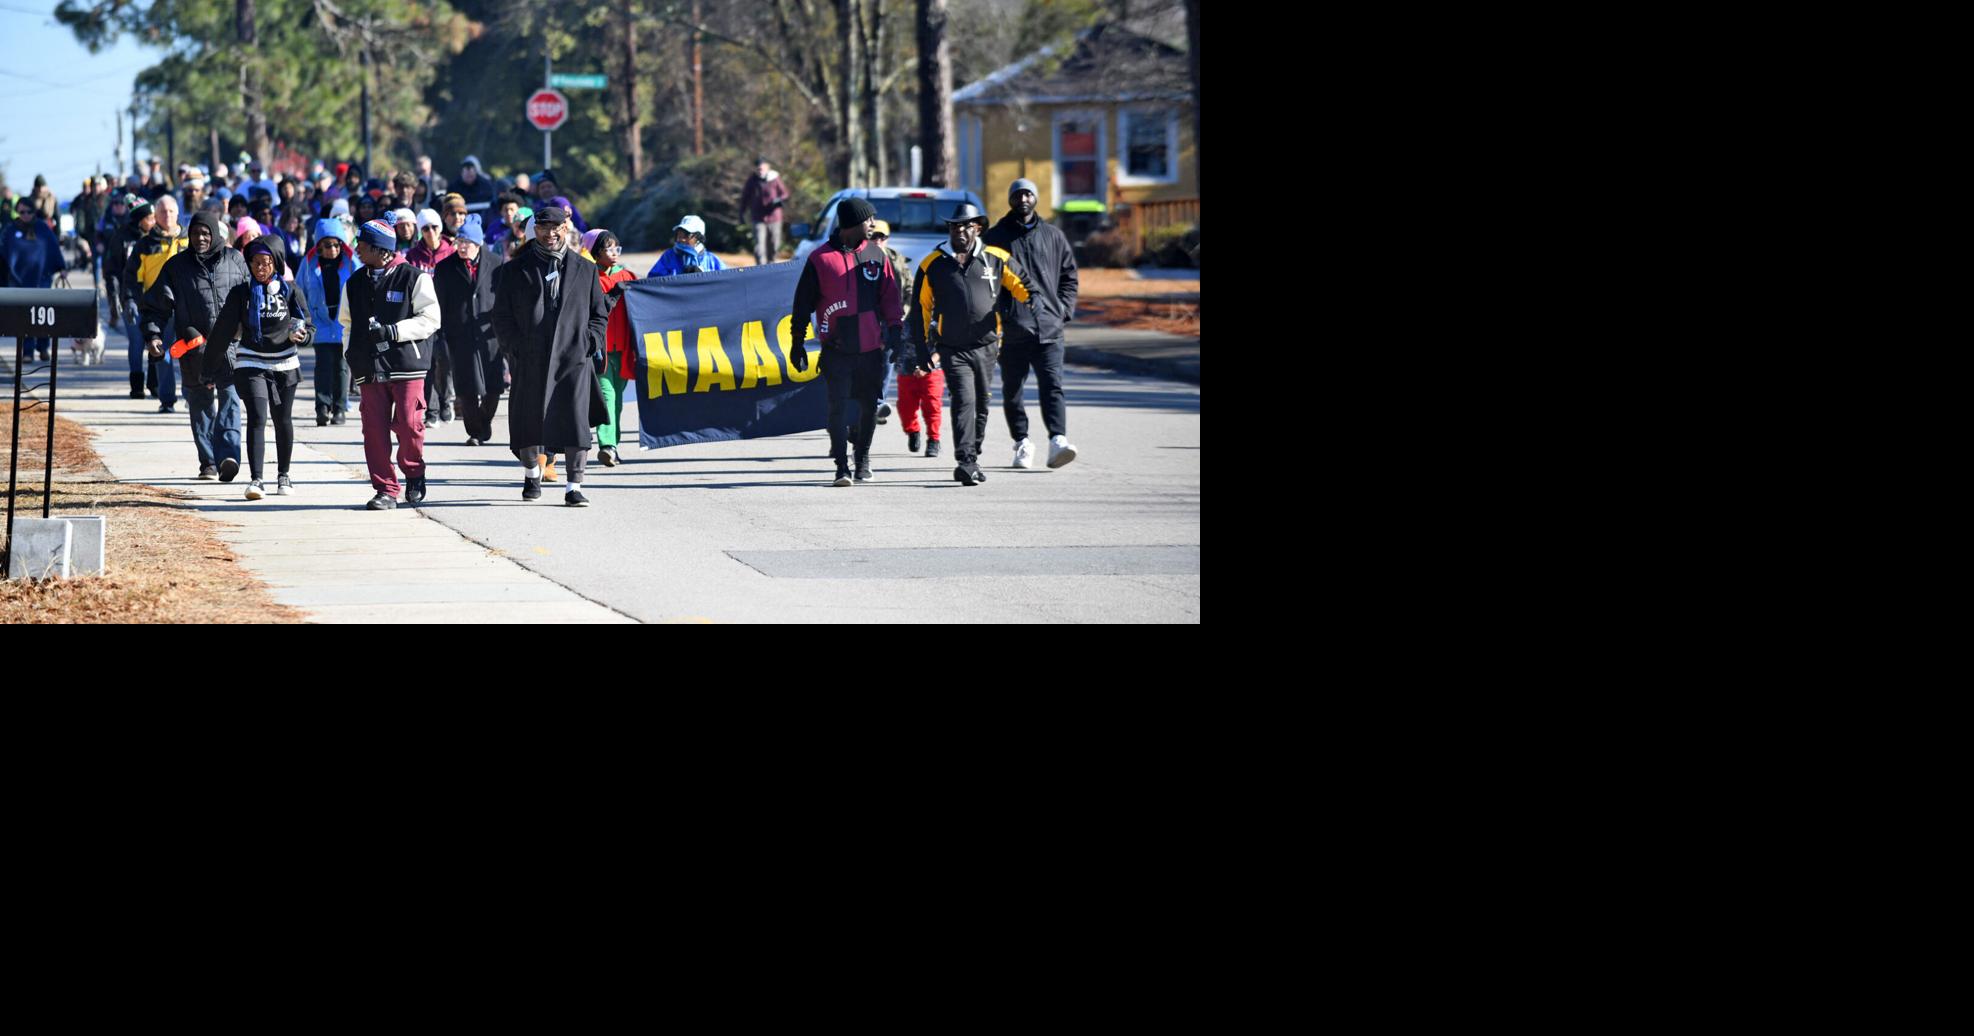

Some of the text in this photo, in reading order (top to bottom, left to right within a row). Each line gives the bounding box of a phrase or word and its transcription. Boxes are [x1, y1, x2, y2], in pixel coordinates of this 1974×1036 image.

[529, 102, 562, 117] STOP
[30, 305, 56, 326] 190
[267, 309, 287, 321] today
[821, 300, 848, 333] CALIFORNIA
